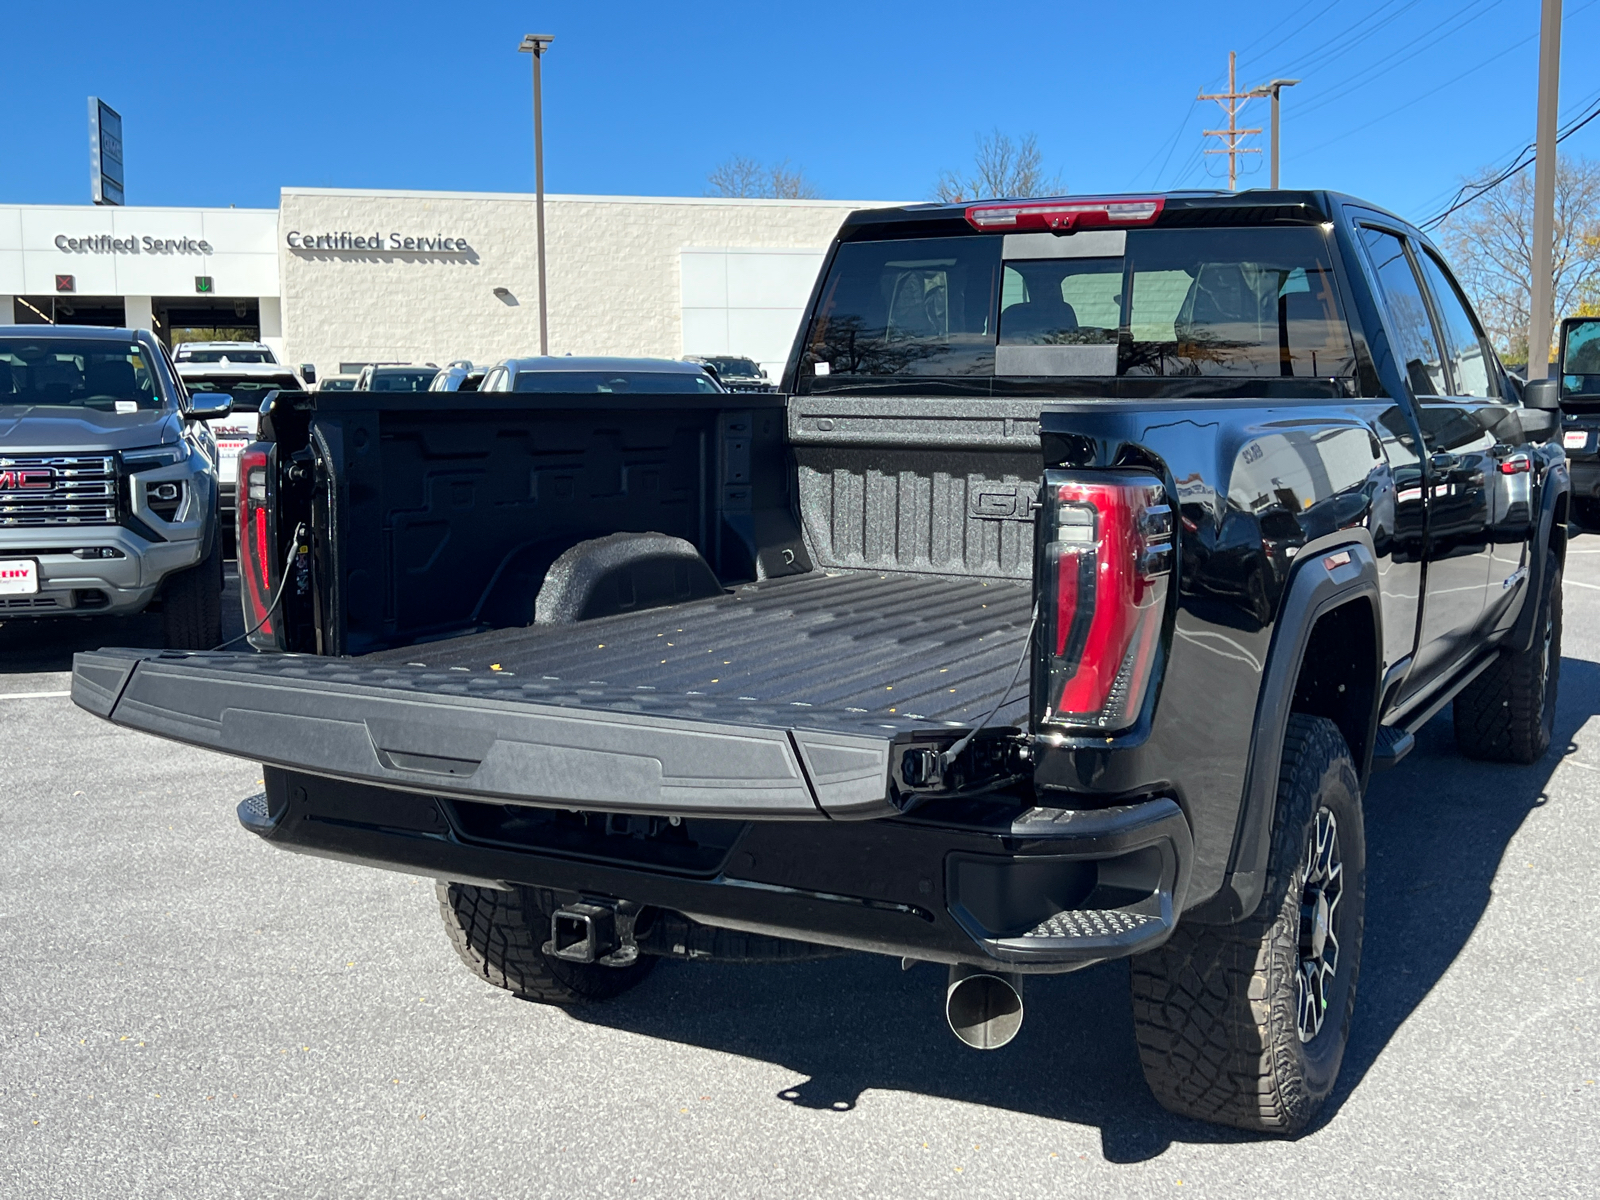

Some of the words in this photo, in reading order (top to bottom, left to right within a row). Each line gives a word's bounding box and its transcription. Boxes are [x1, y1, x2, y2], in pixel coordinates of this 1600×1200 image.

[54, 234, 135, 251] Certified
[142, 235, 209, 251] Service
[286, 230, 380, 250] Certified
[389, 232, 467, 251] Service
[0, 568, 29, 578] EHY
